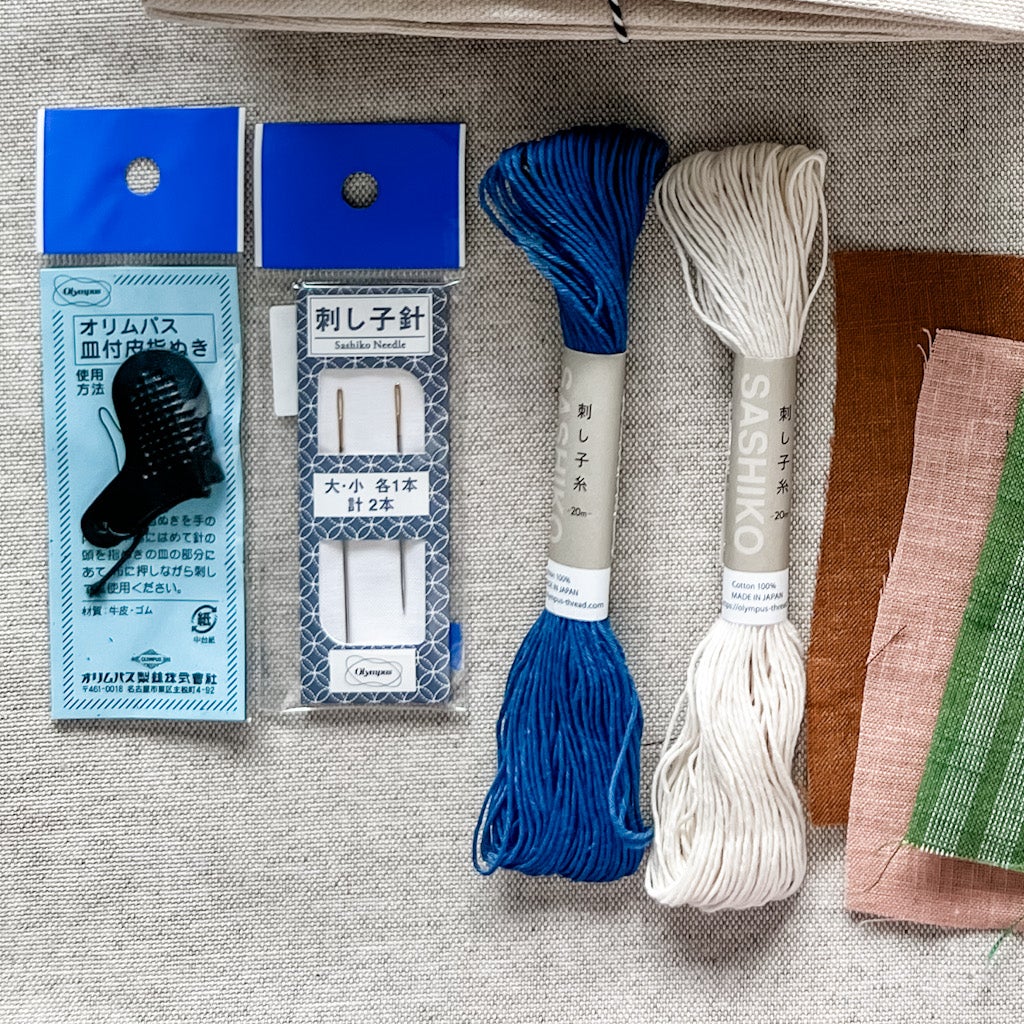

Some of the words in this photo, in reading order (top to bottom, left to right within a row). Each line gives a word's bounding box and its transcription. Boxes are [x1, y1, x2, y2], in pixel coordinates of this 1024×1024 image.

[63, 287, 102, 297] Olympus
[314, 305, 426, 332] 刺し子針
[80, 317, 178, 336] オリムパス
[334, 340, 371, 350] Sashiko
[373, 340, 406, 350] Needle
[76, 368, 104, 382] 使用
[76, 383, 105, 396] 方法
[573, 402, 593, 493] 刺し子糸
[776, 405, 792, 495] 刺し子糸
[733, 373, 770, 556] SASHIKO
[375, 477, 418, 493] 各1本
[731, 580, 755, 589] Cotton
[758, 582, 777, 590] 100%
[731, 591, 751, 601] MADE
[752, 593, 761, 601] IN
[763, 592, 784, 601] JAPAN
[354, 667, 393, 677] Olympus
